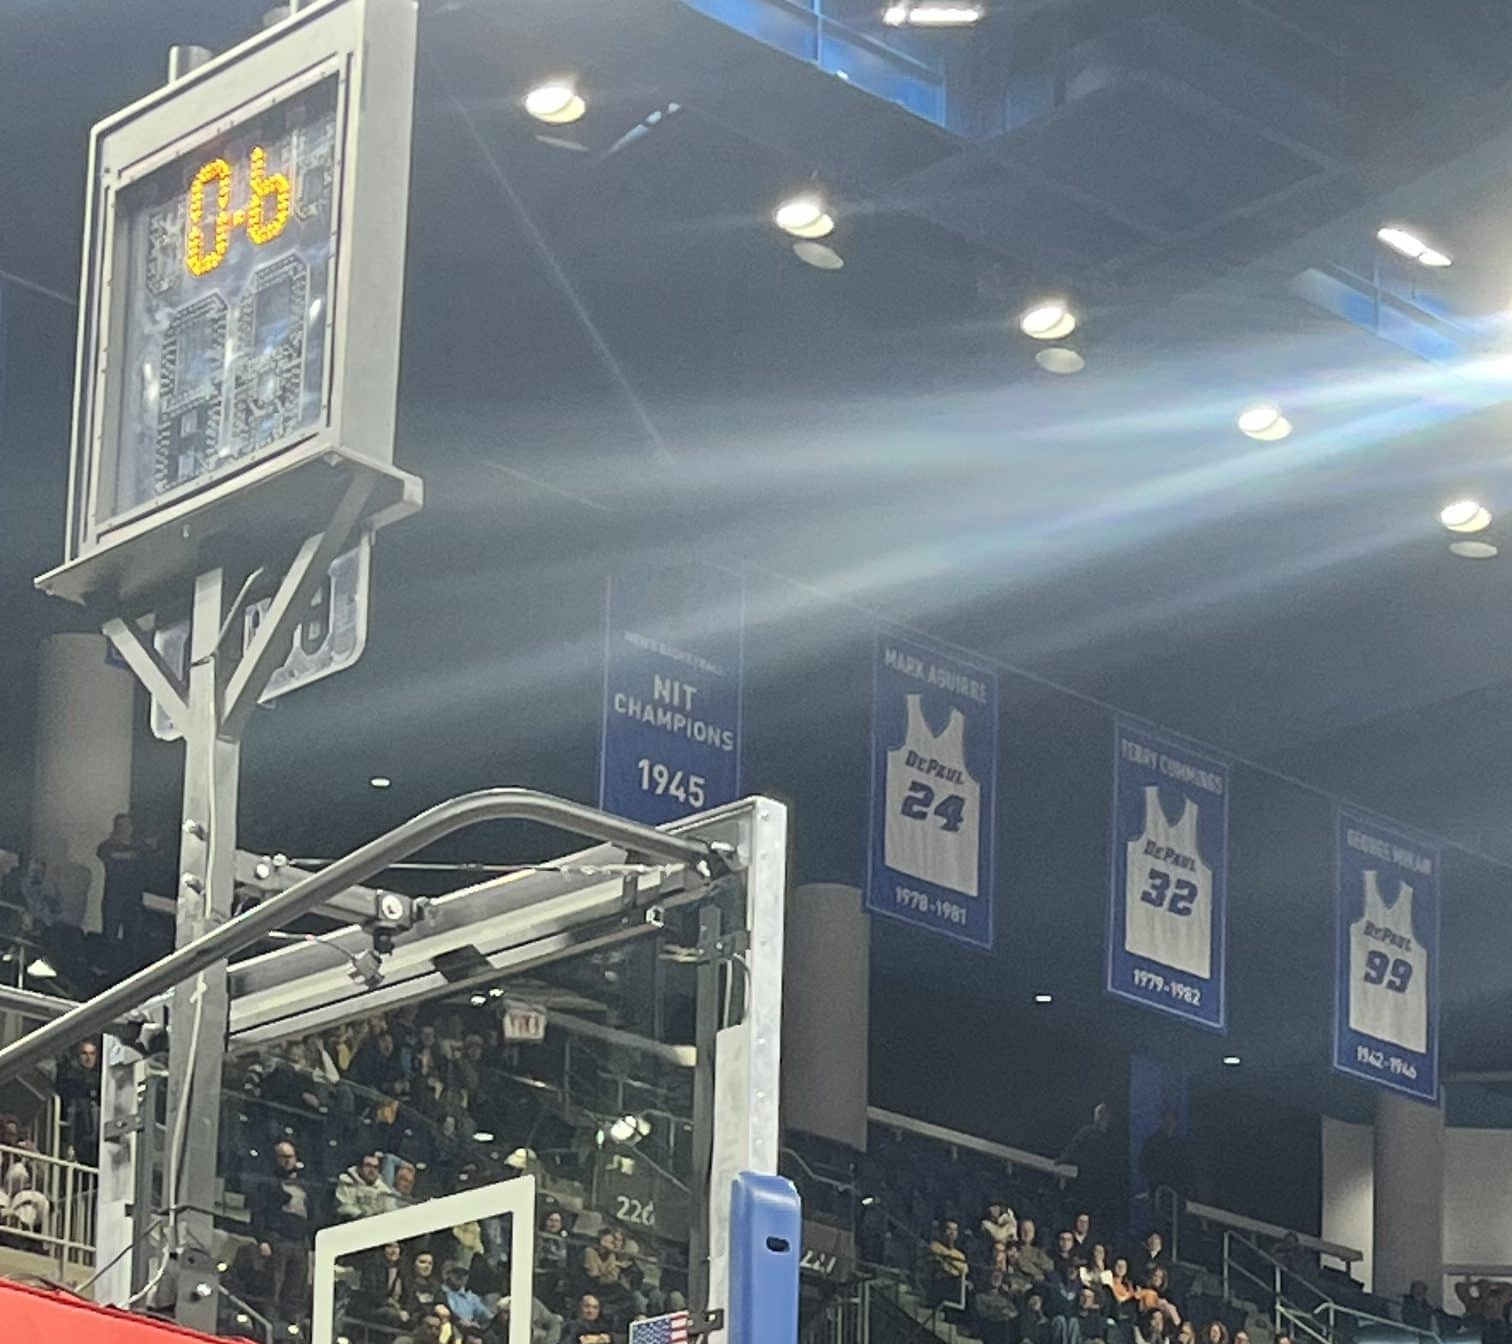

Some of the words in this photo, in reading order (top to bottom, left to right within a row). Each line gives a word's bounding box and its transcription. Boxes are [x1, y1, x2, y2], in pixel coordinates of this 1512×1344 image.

[653, 673, 697, 712] NIT
[613, 693, 734, 751] CHAMPIONS
[638, 758, 705, 808] 1945
[901, 780, 966, 832] 24
[895, 886, 967, 924] 1978-1981
[1139, 868, 1199, 917] 32
[1133, 968, 1202, 1007] 1979-1982
[1363, 950, 1413, 993] 99
